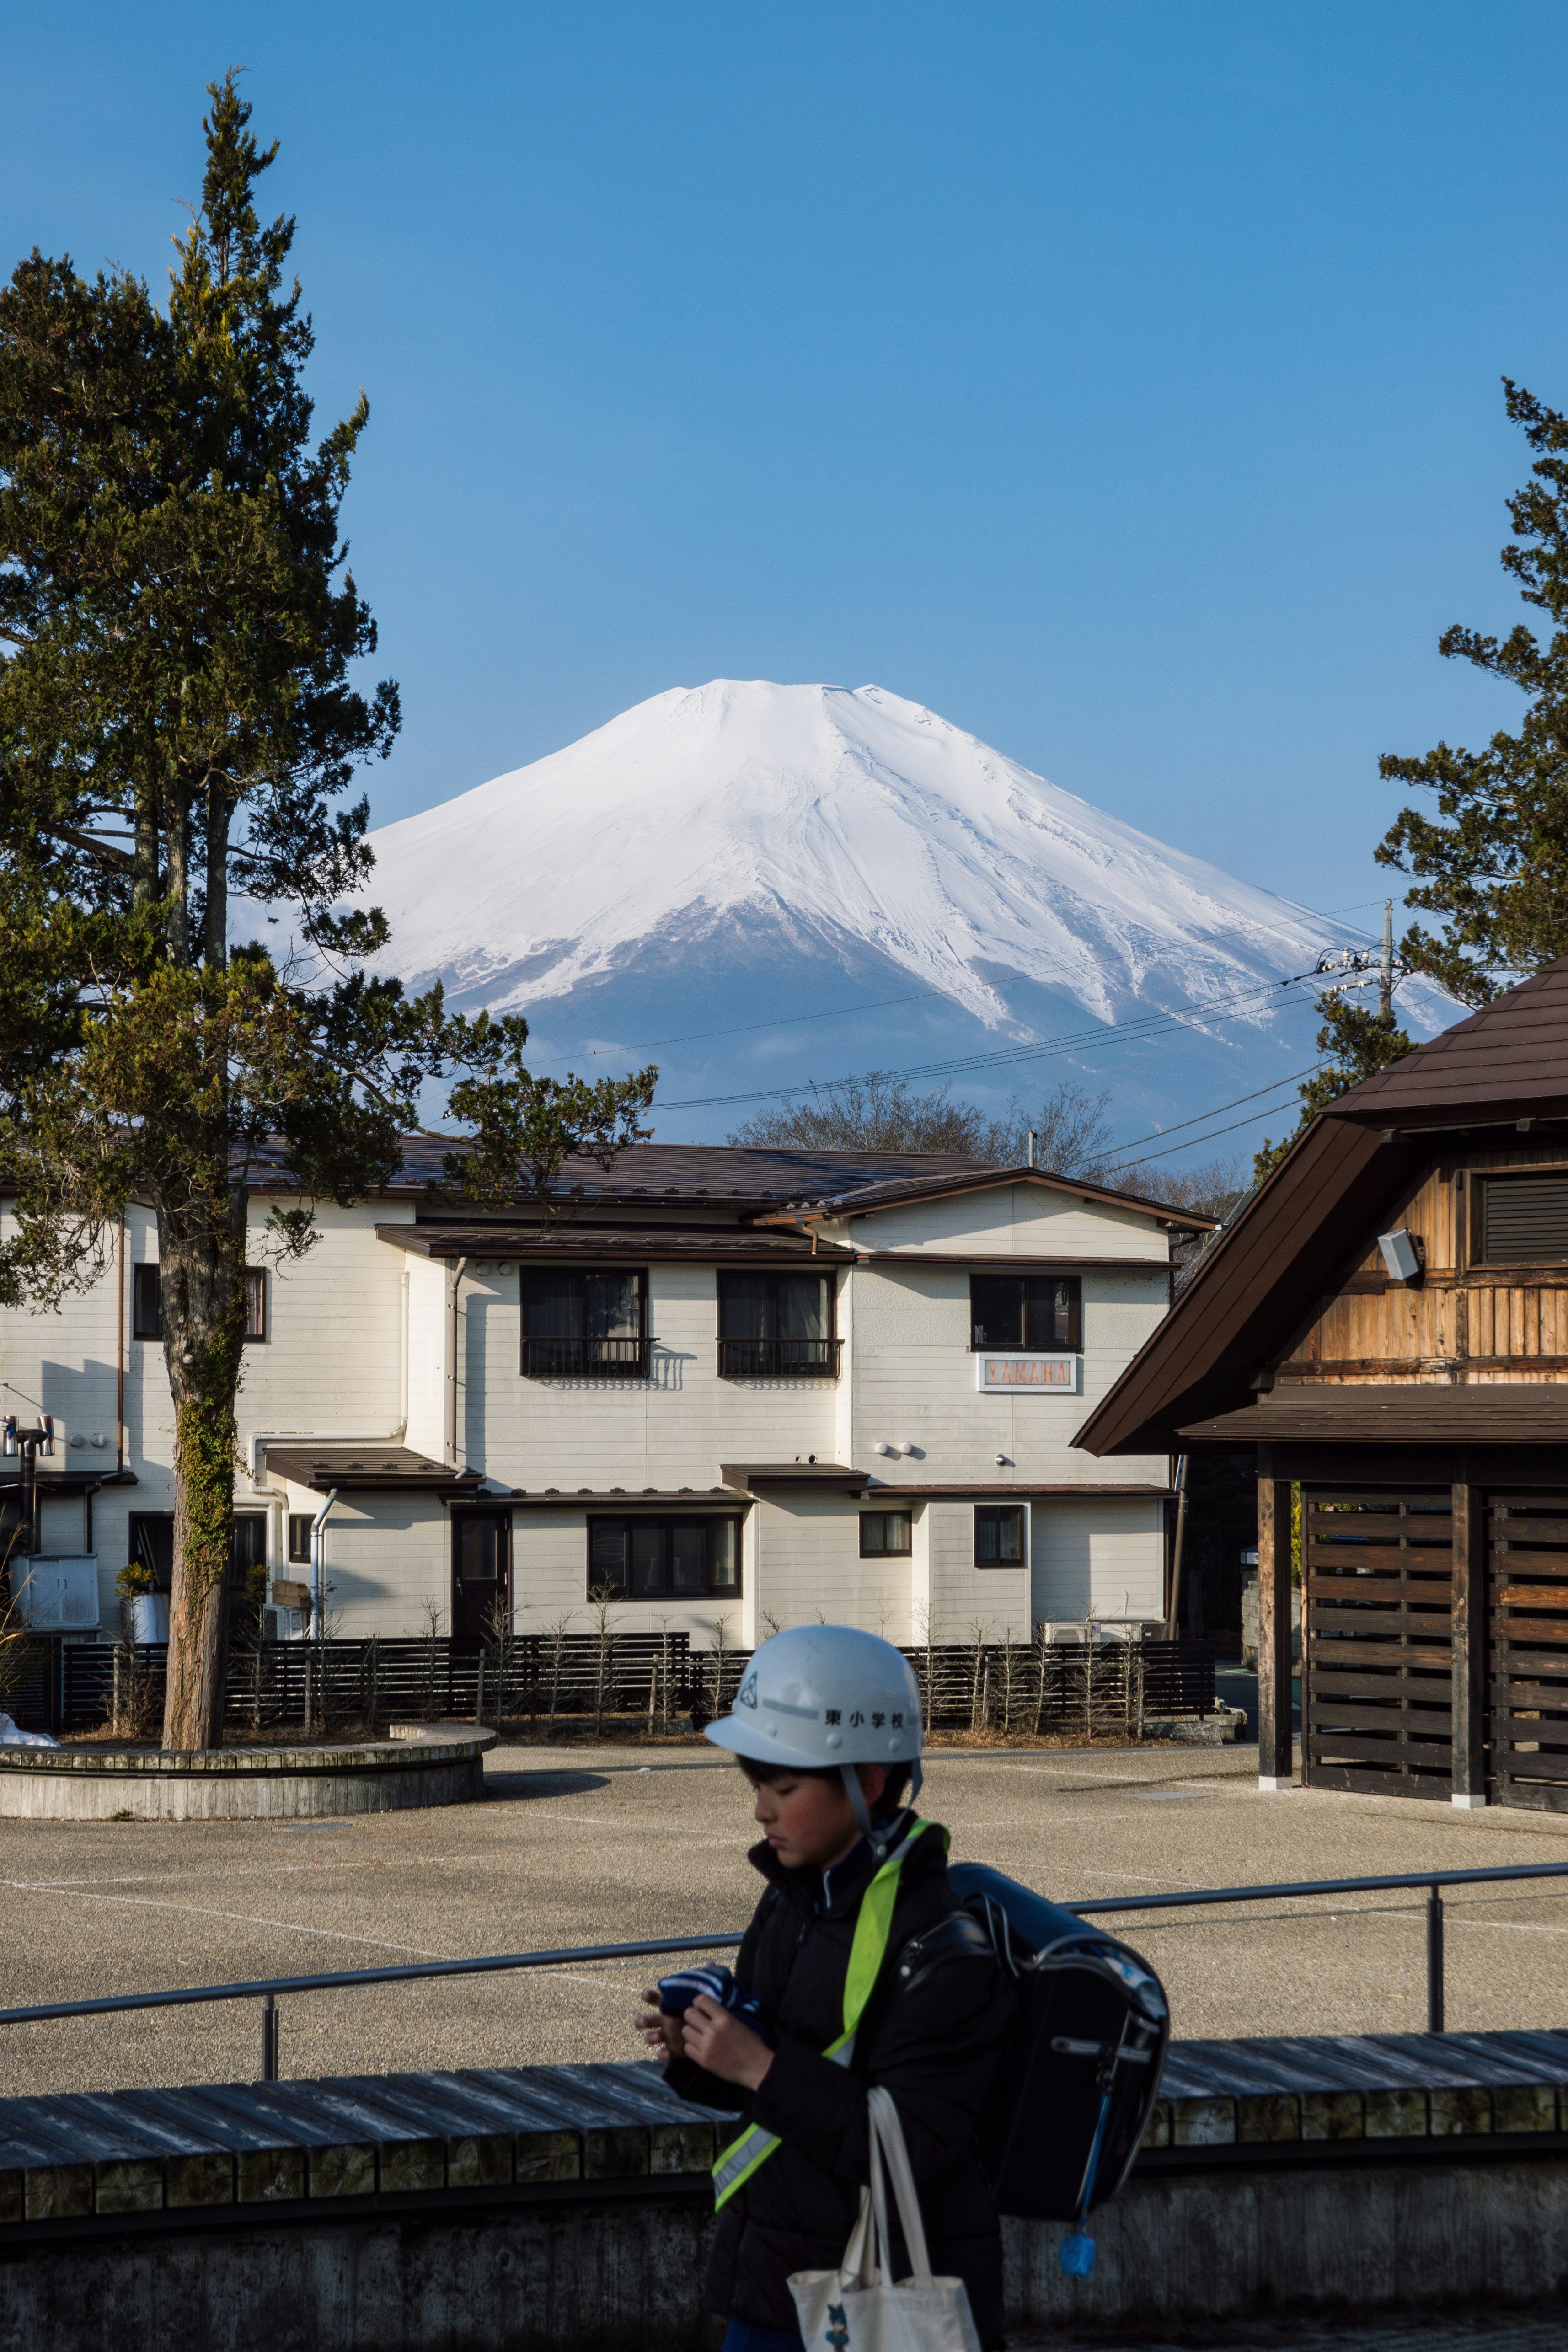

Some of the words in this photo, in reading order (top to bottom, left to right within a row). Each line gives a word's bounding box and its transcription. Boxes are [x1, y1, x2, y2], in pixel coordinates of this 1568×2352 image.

[988, 1361, 1067, 1383] YAMAHA
[825, 1709, 904, 1729] 東小学校
